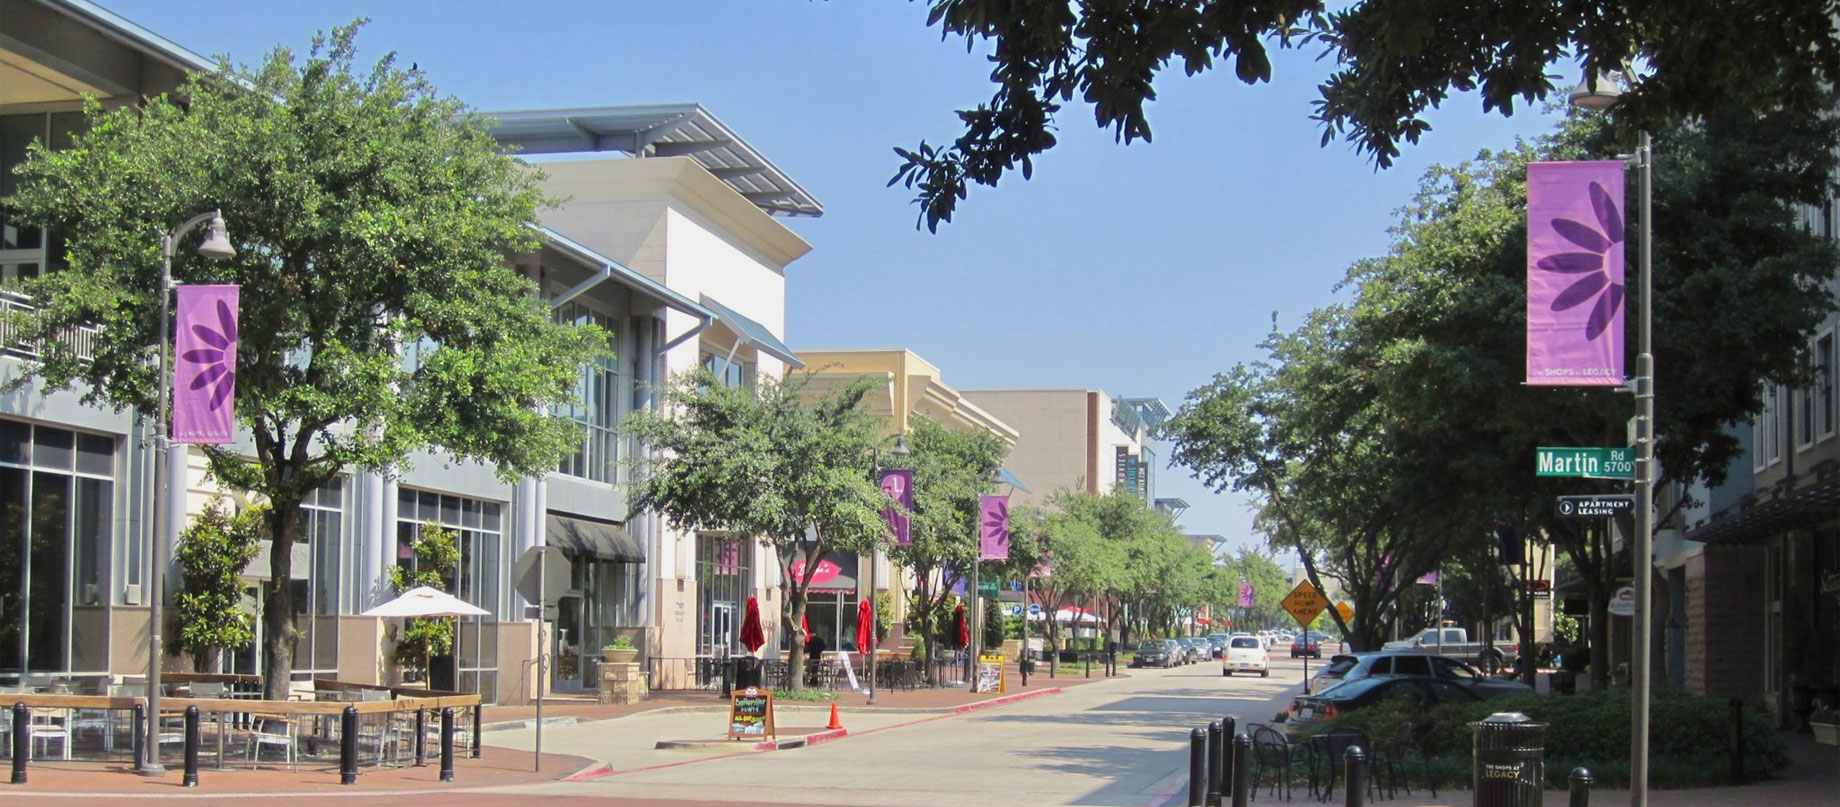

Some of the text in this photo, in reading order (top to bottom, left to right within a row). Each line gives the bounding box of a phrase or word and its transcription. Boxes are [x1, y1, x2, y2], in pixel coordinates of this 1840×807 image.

[1544, 368, 1574, 376] SHOPS
[1582, 368, 1617, 376] LEGACY
[1611, 450, 1624, 461] Rd
[1539, 452, 1598, 472] Martin
[1604, 461, 1631, 472] 5700
[1118, 453, 1126, 483] MOVIES
[1485, 770, 1520, 779] LEGACY
